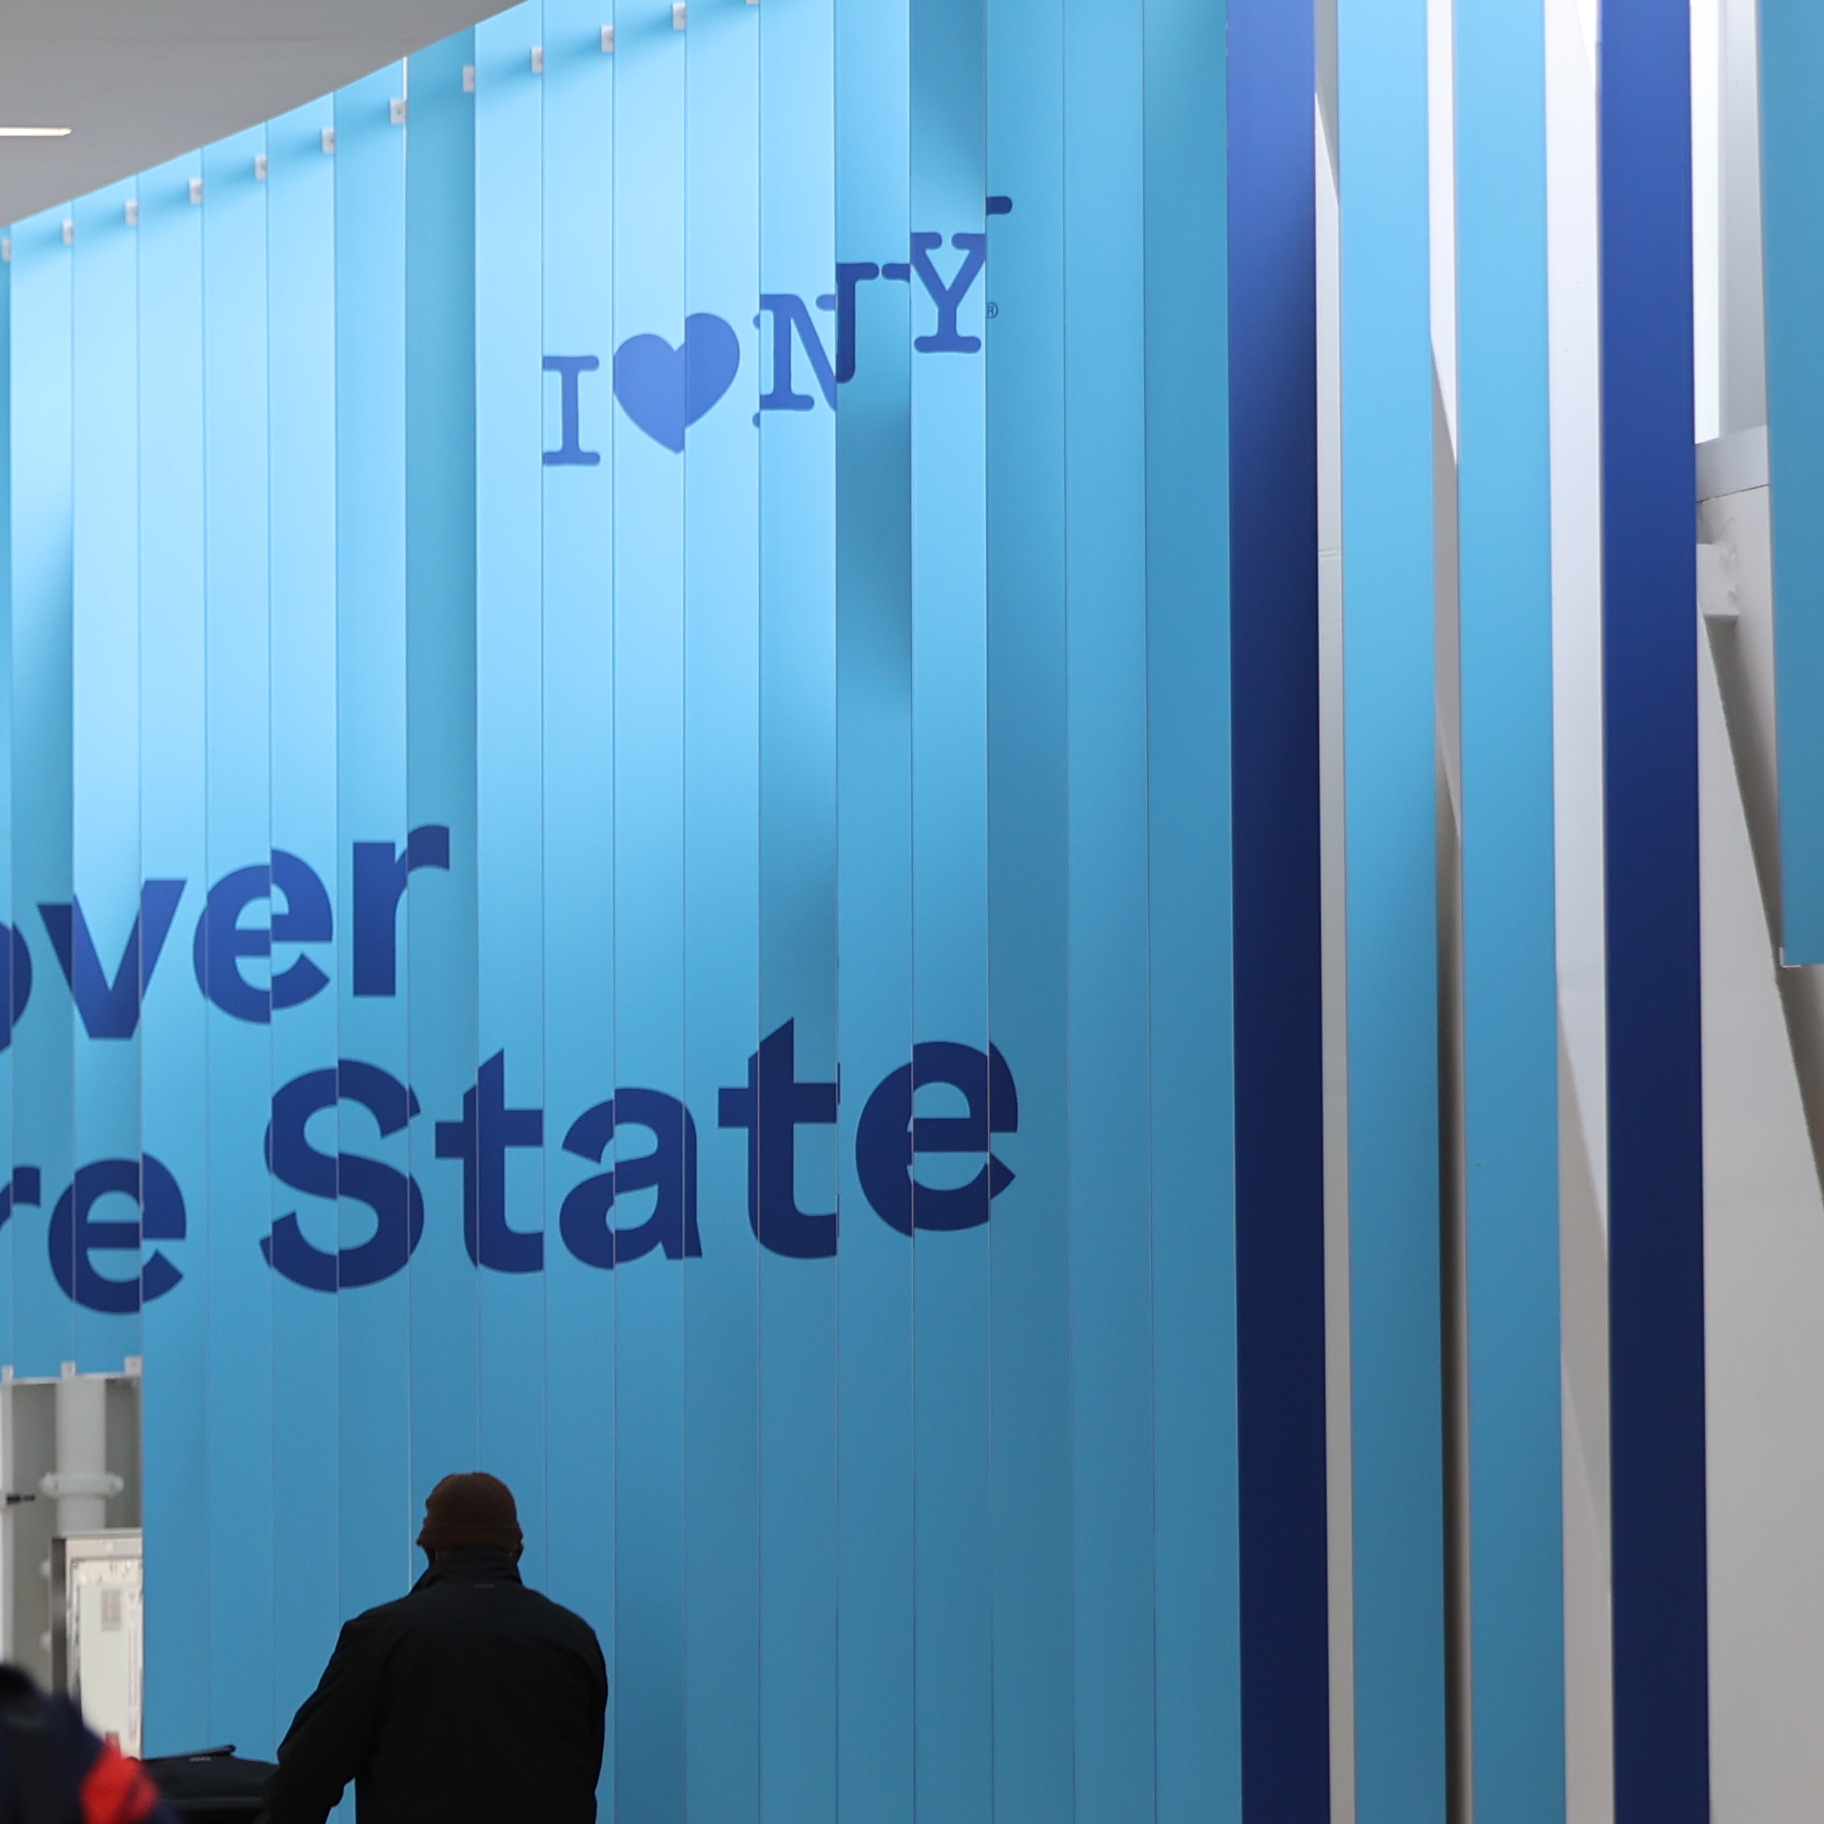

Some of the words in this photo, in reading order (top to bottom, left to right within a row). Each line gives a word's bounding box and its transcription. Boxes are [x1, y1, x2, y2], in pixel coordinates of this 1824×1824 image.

[542, 355, 601, 467] I
[752, 196, 1013, 429] NY
[260, 1017, 1020, 1292] State
